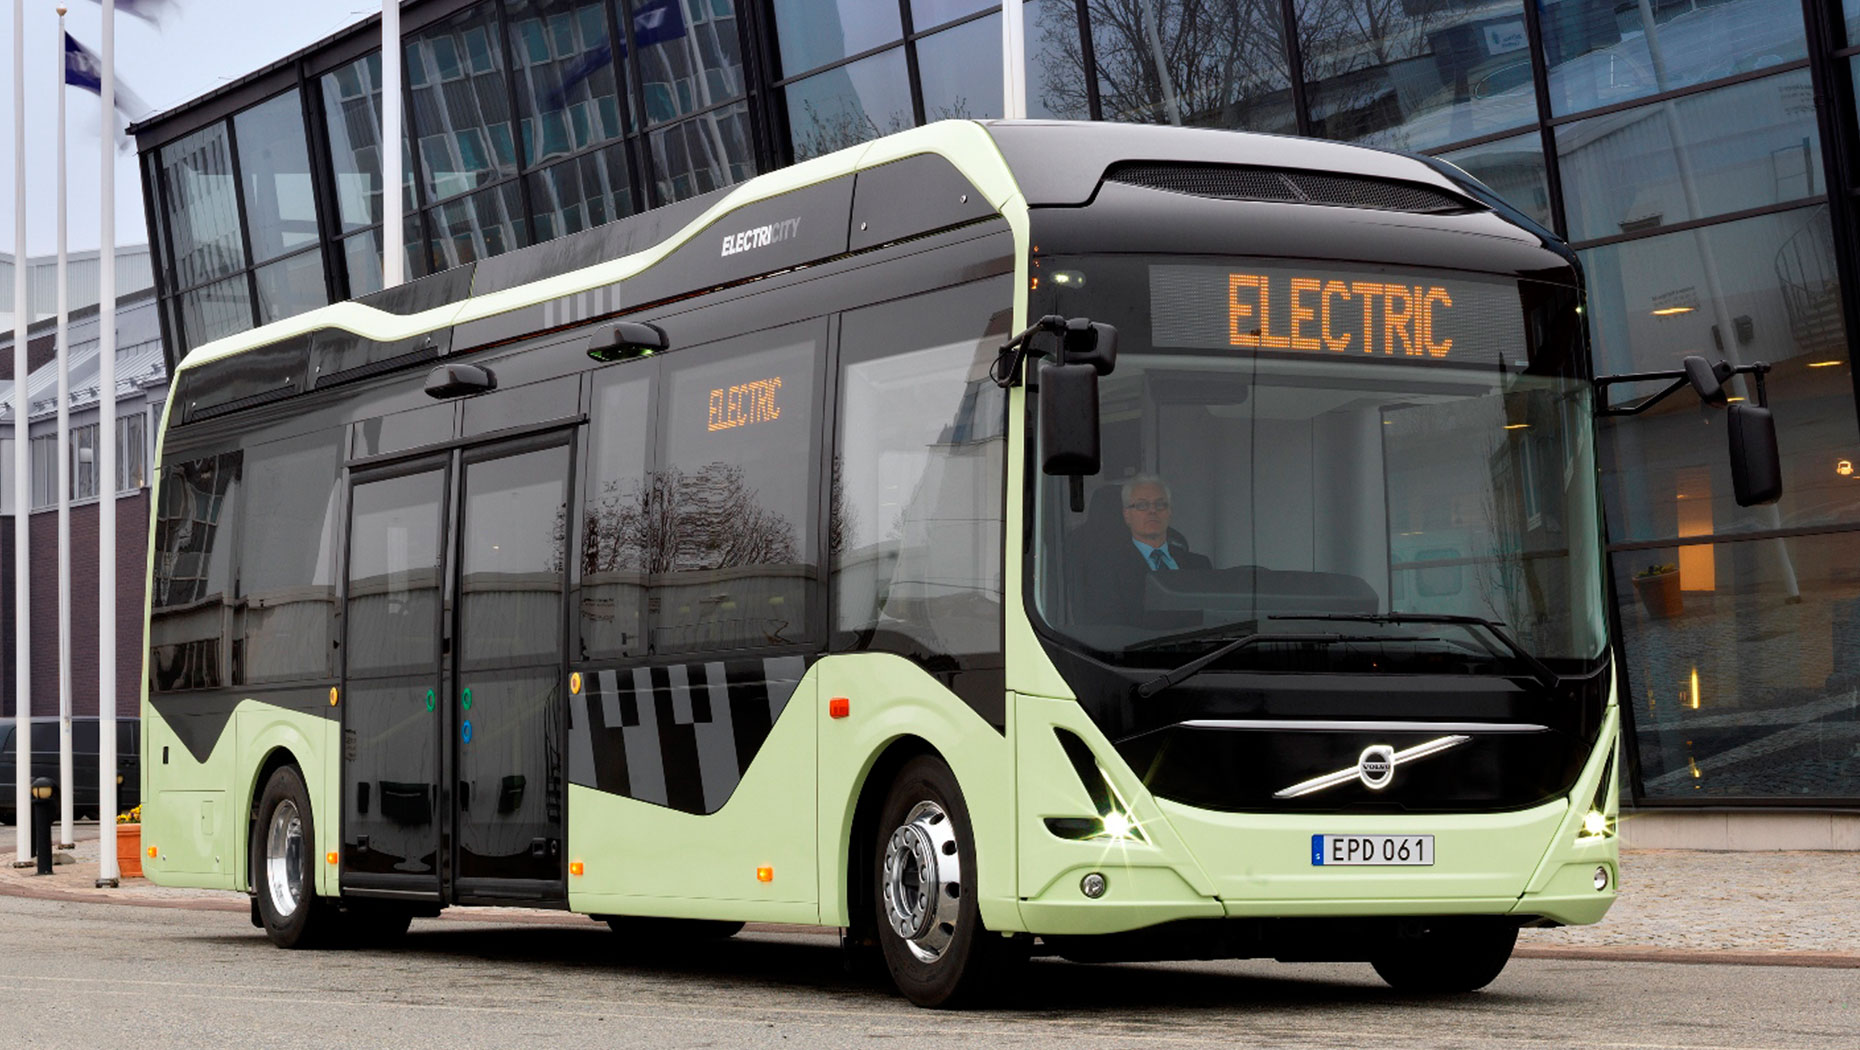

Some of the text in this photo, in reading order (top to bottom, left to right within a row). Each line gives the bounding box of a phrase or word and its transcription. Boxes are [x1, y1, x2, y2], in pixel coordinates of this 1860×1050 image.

[721, 216, 801, 257] ELECTRICITY
[1229, 273, 1453, 358] ELECTRIC
[708, 376, 782, 432] ELECTRIC
[1332, 838, 1423, 861] EPD 061
